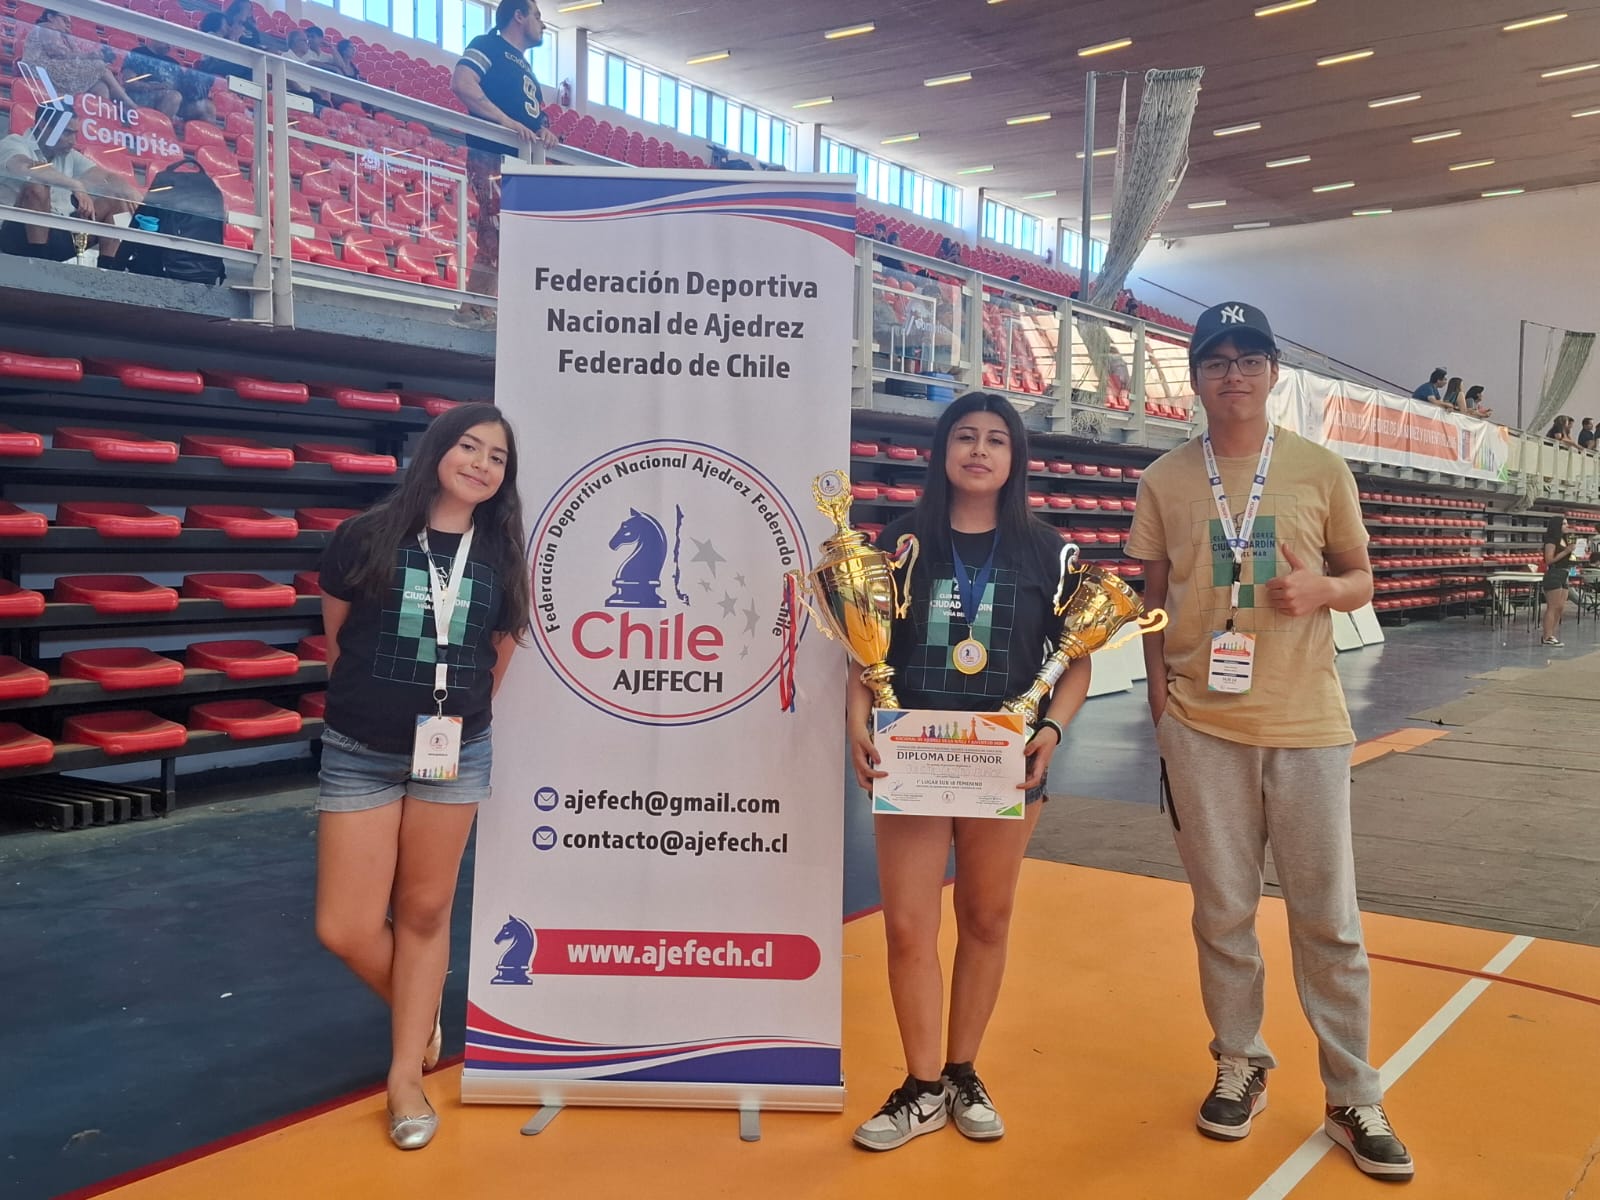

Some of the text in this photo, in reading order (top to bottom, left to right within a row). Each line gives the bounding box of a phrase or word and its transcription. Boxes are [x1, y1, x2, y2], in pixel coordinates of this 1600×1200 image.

[82, 93, 139, 125] Chile
[82, 118, 180, 157] Compite
[535, 267, 818, 302] Federación Deportiva
[547, 308, 804, 343] Nacional de Ajedrez
[558, 349, 791, 379] Federado de Chile
[614, 454, 687, 478] Nacional
[692, 457, 752, 497] Ajedrez
[547, 474, 613, 539] Deportiva
[750, 492, 795, 566] Federado
[538, 543, 560, 633] Federación
[571, 610, 724, 662] Chile
[613, 669, 723, 695] AJEFECH
[897, 751, 1003, 764] DIPLOMA DE HONOR
[564, 789, 780, 816] ajefech@gmail.com
[562, 830, 788, 856] contacto@ajefech.cl
[567, 939, 773, 971] www.ajefech.cl
